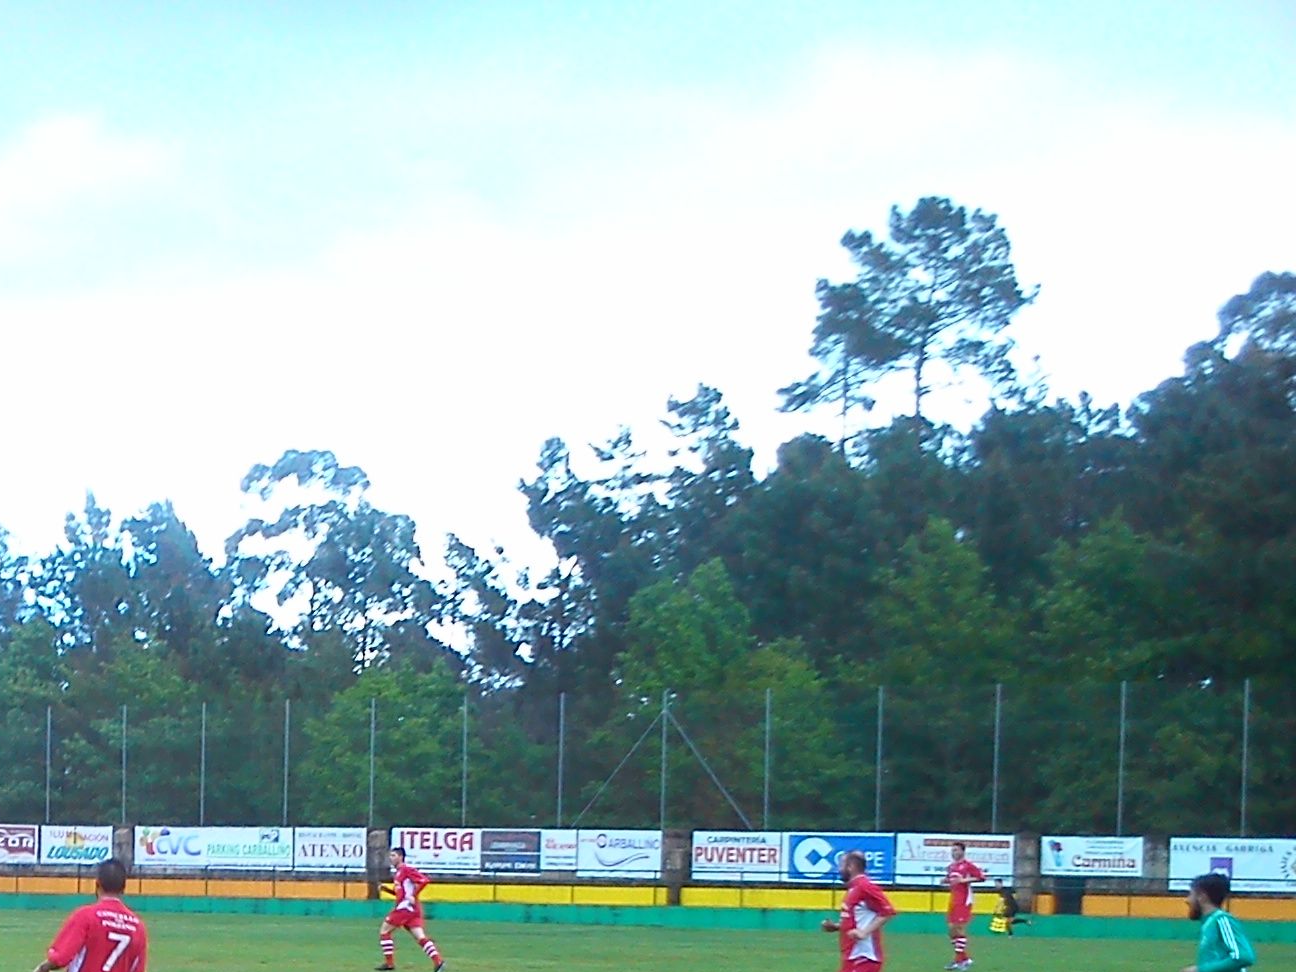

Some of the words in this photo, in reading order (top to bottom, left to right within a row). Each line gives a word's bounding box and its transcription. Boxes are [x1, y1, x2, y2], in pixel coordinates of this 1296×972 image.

[298, 842, 364, 859] ATENEO
[694, 845, 778, 865] PUVENTER
[102, 931, 131, 972] 7
